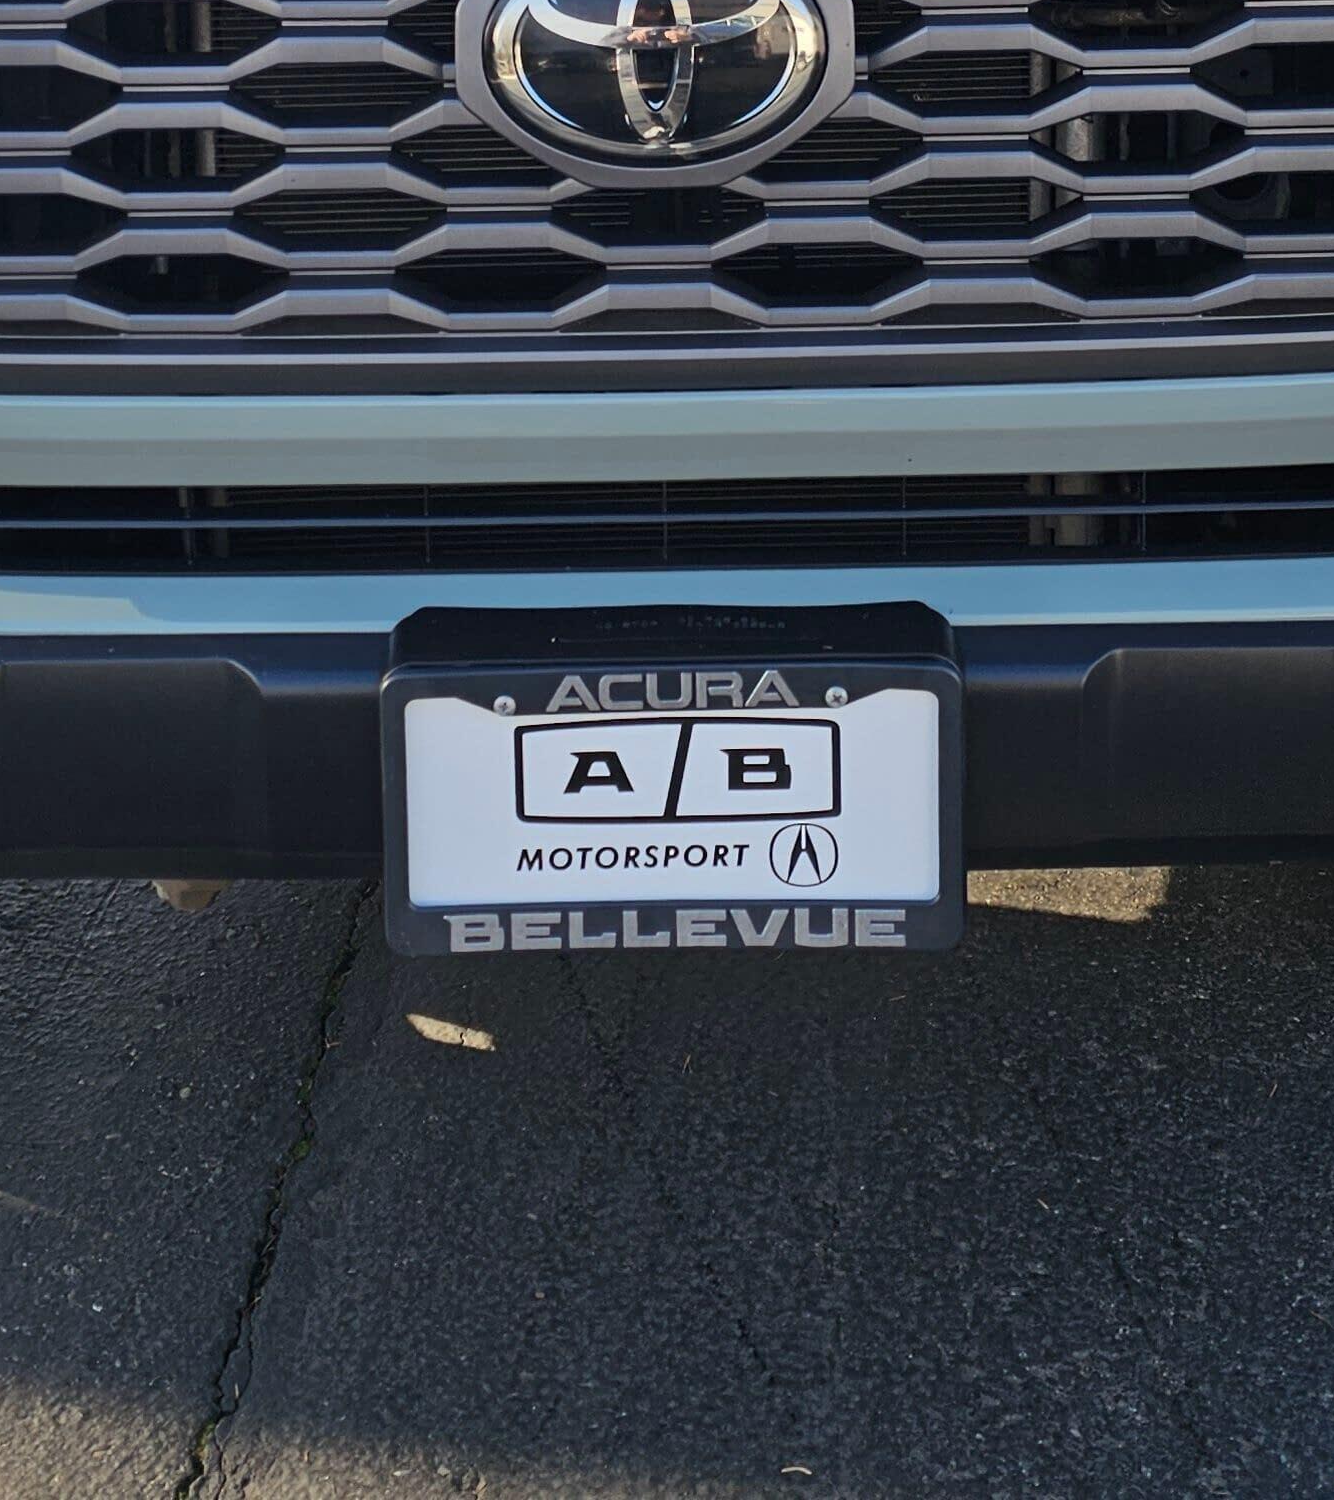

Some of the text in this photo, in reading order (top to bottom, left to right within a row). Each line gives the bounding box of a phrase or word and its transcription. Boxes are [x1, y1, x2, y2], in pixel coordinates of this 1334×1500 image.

[546, 670, 800, 713] ACURA
[563, 748, 792, 794] A B
[516, 843, 750, 871] MOTORSPORT
[443, 907, 907, 953] BELLEVUE
